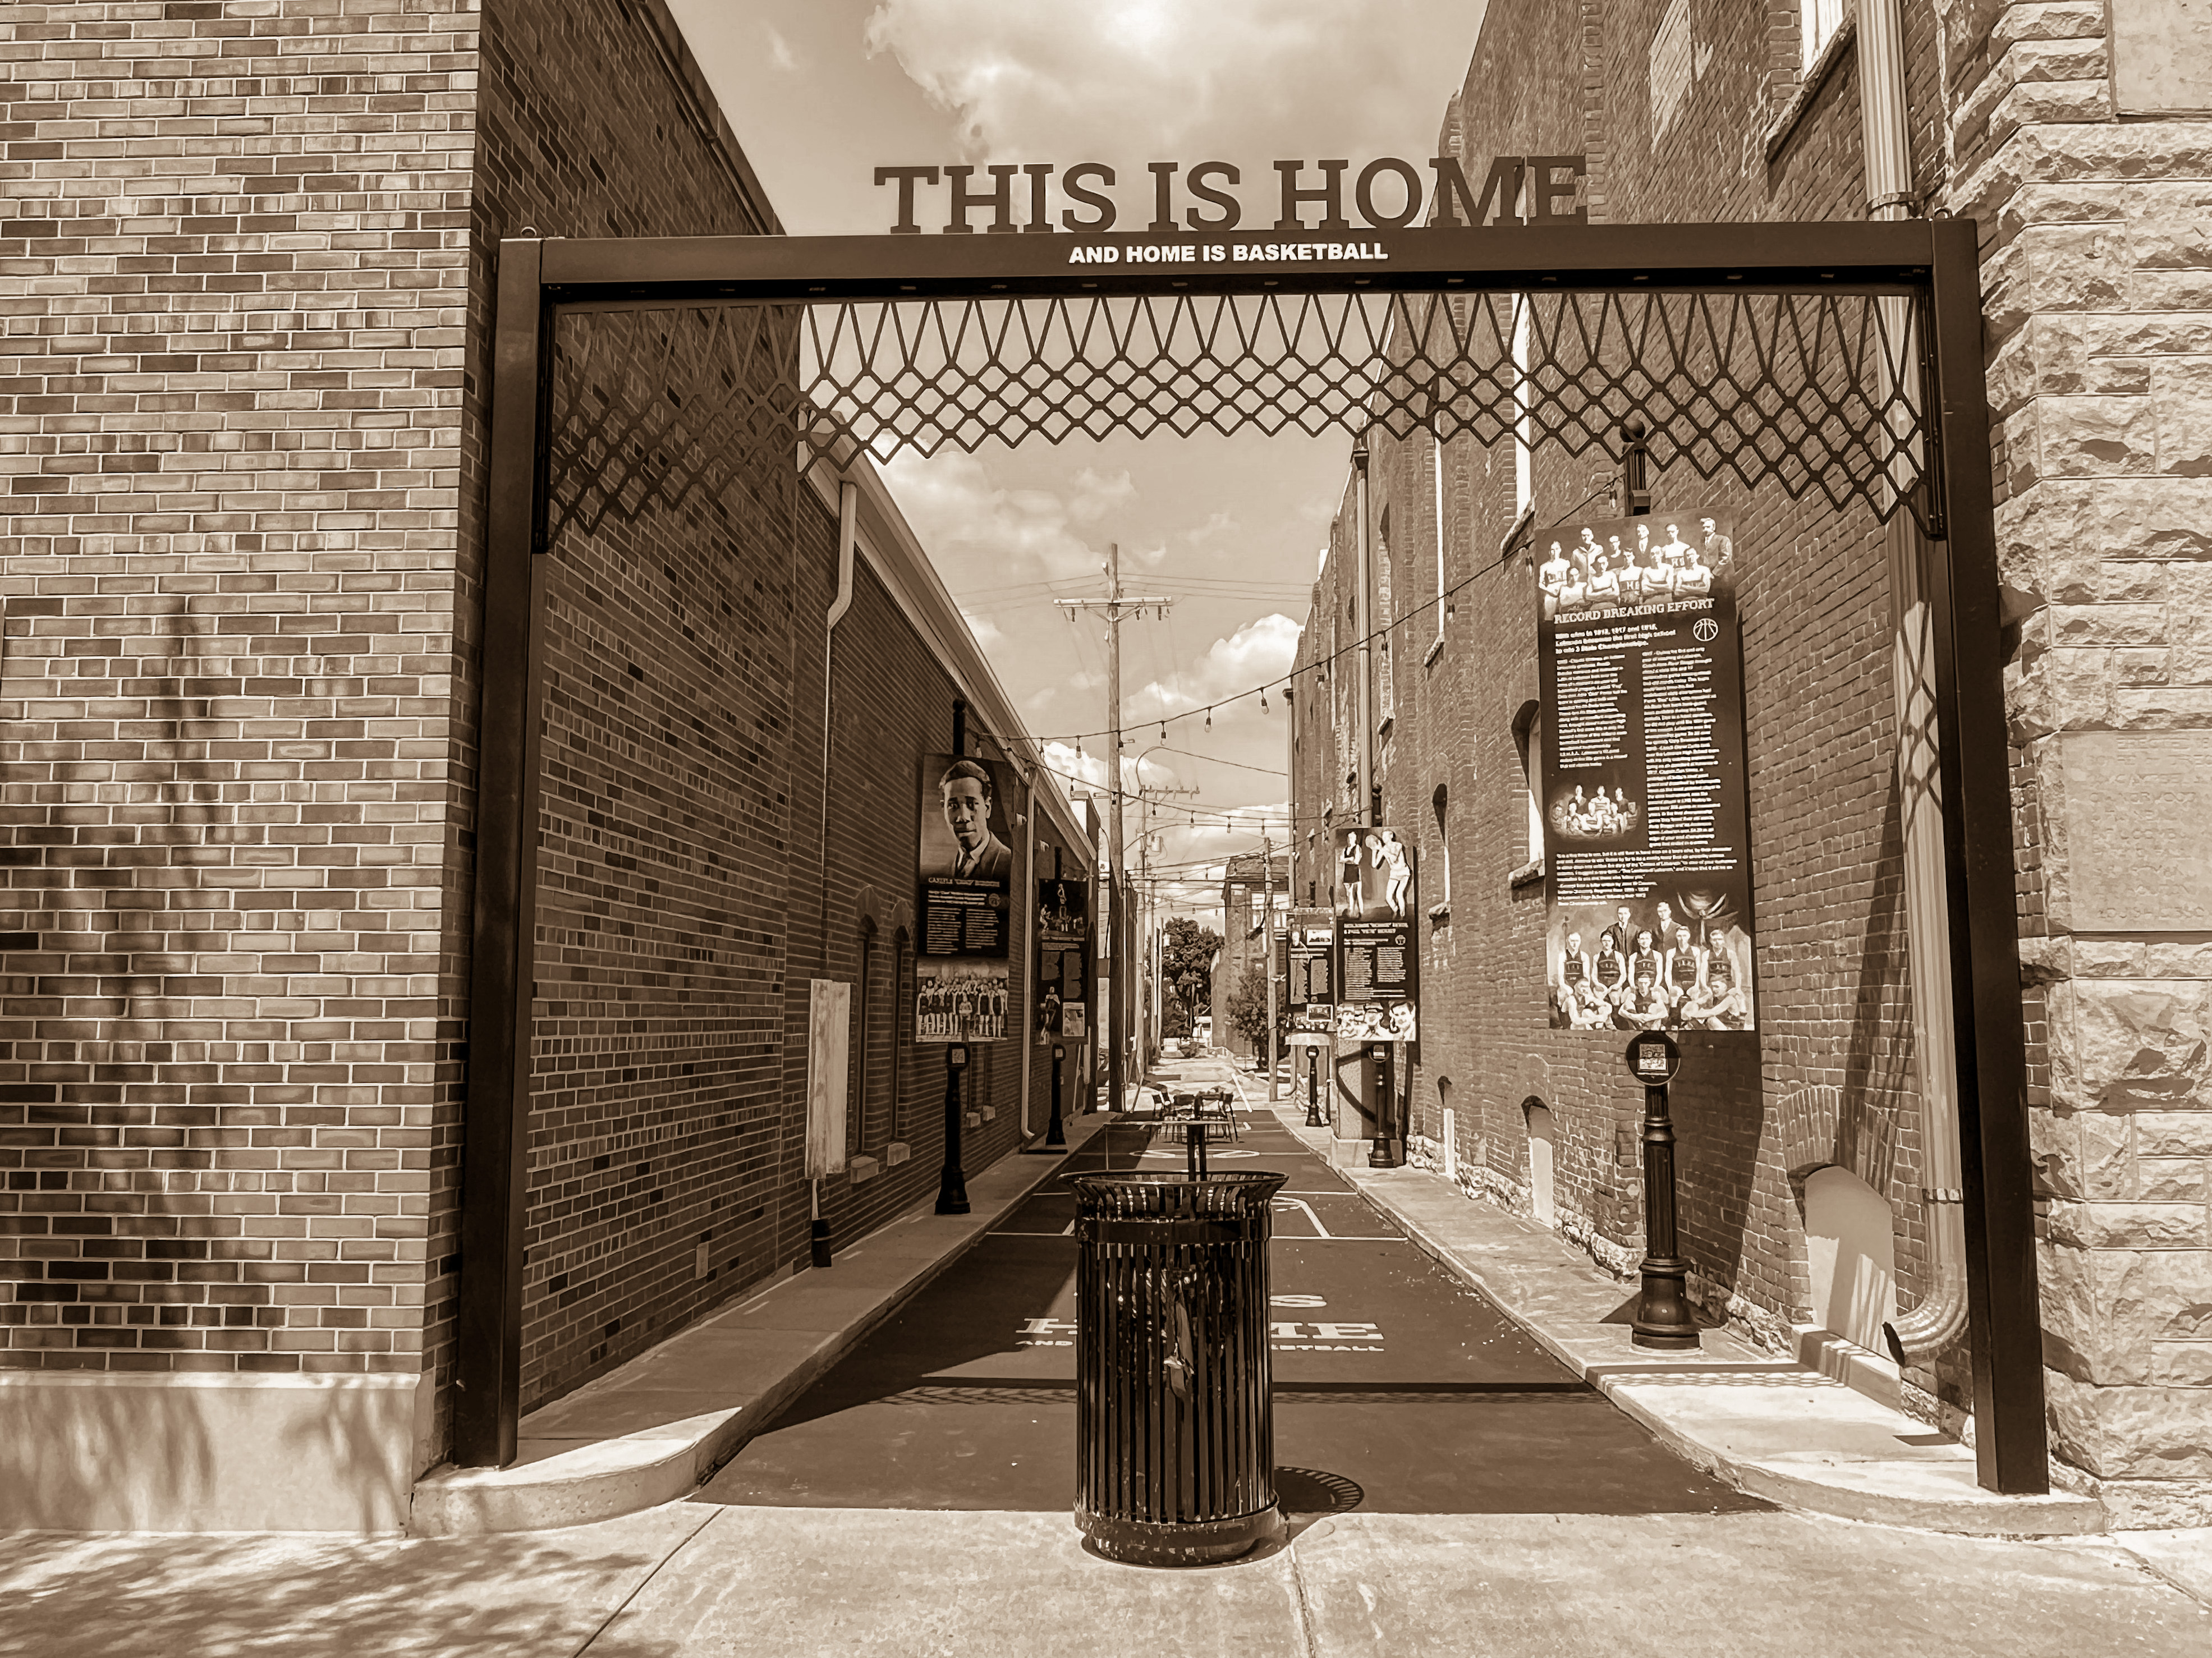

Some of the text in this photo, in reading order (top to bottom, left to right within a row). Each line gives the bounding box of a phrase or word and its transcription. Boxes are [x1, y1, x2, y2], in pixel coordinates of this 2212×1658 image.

[874, 156, 1587, 234] THIS IS HOME
[1069, 243, 1389, 264] AND HOME IS BASKETBALL
[1554, 598, 1715, 624] RECORD BREAKING EFFORT
